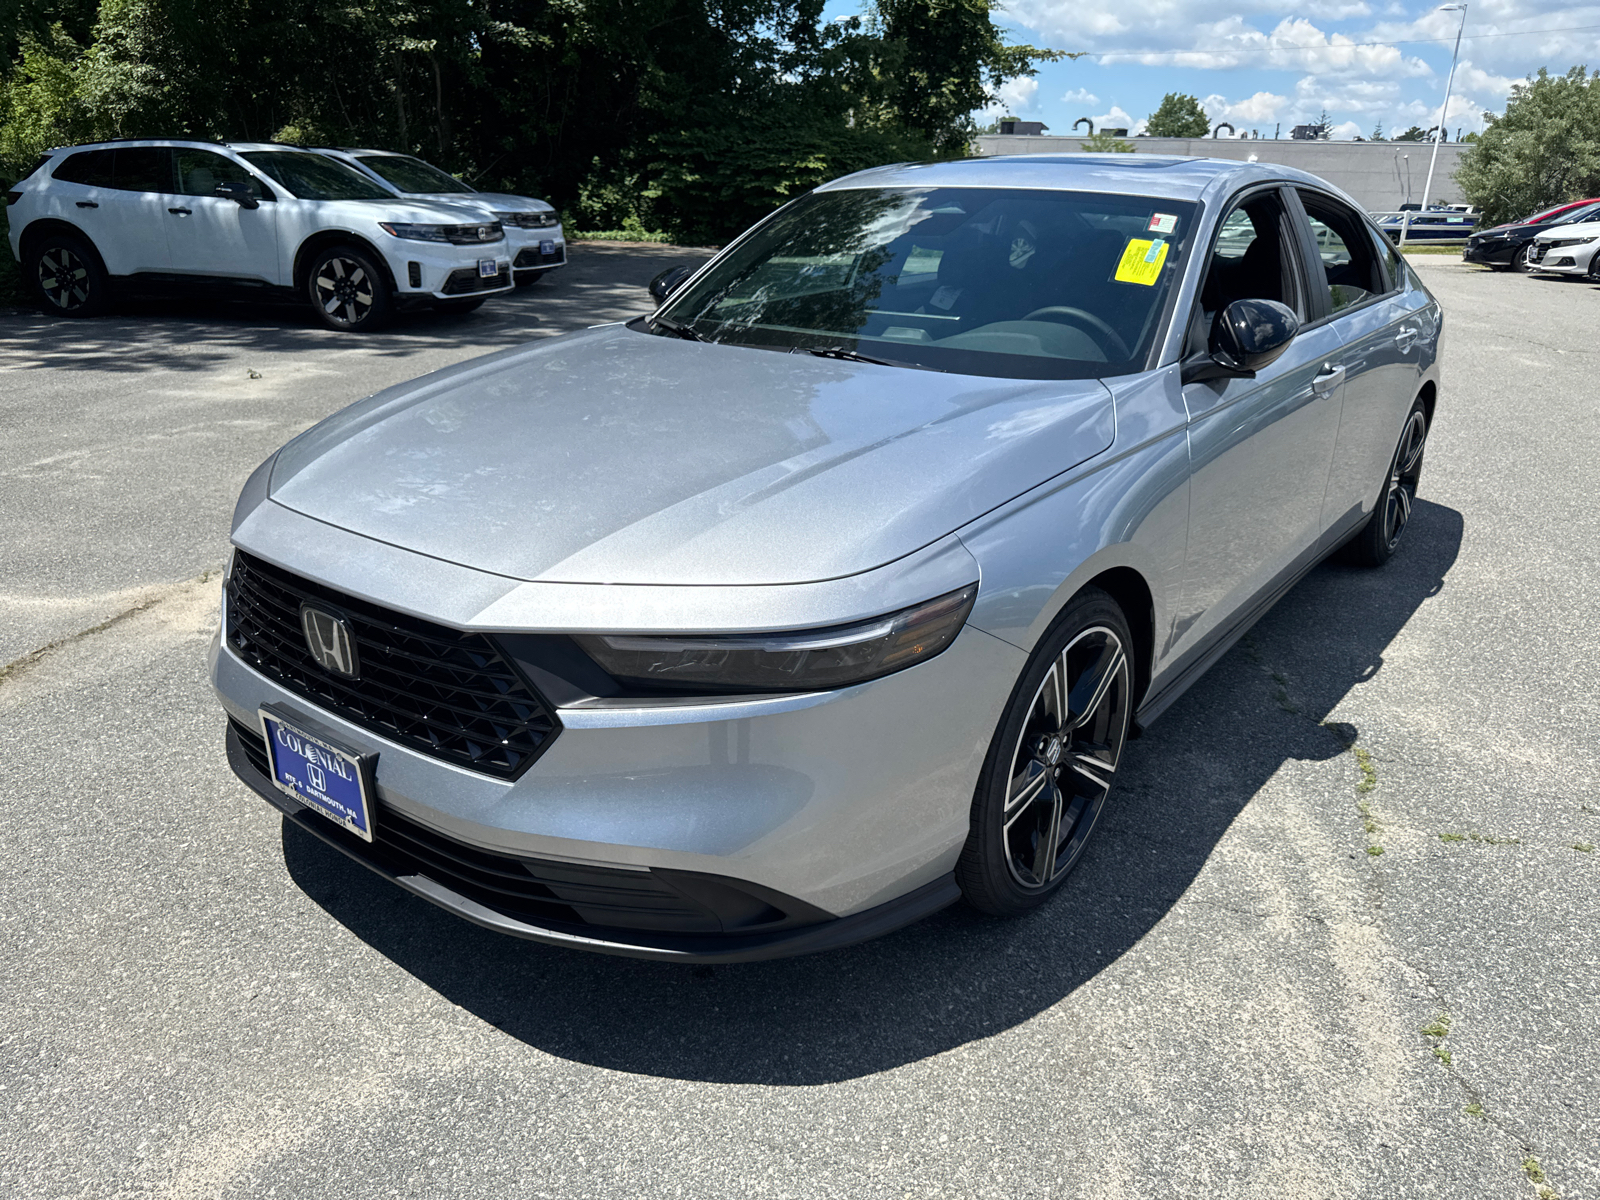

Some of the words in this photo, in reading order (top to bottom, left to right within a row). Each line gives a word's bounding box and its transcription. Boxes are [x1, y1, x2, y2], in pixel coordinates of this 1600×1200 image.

[277, 728, 352, 782] COLONIAL
[306, 785, 346, 814] DARTMOUTH,
[346, 807, 358, 820] MA
[325, 810, 347, 828] HONDA
